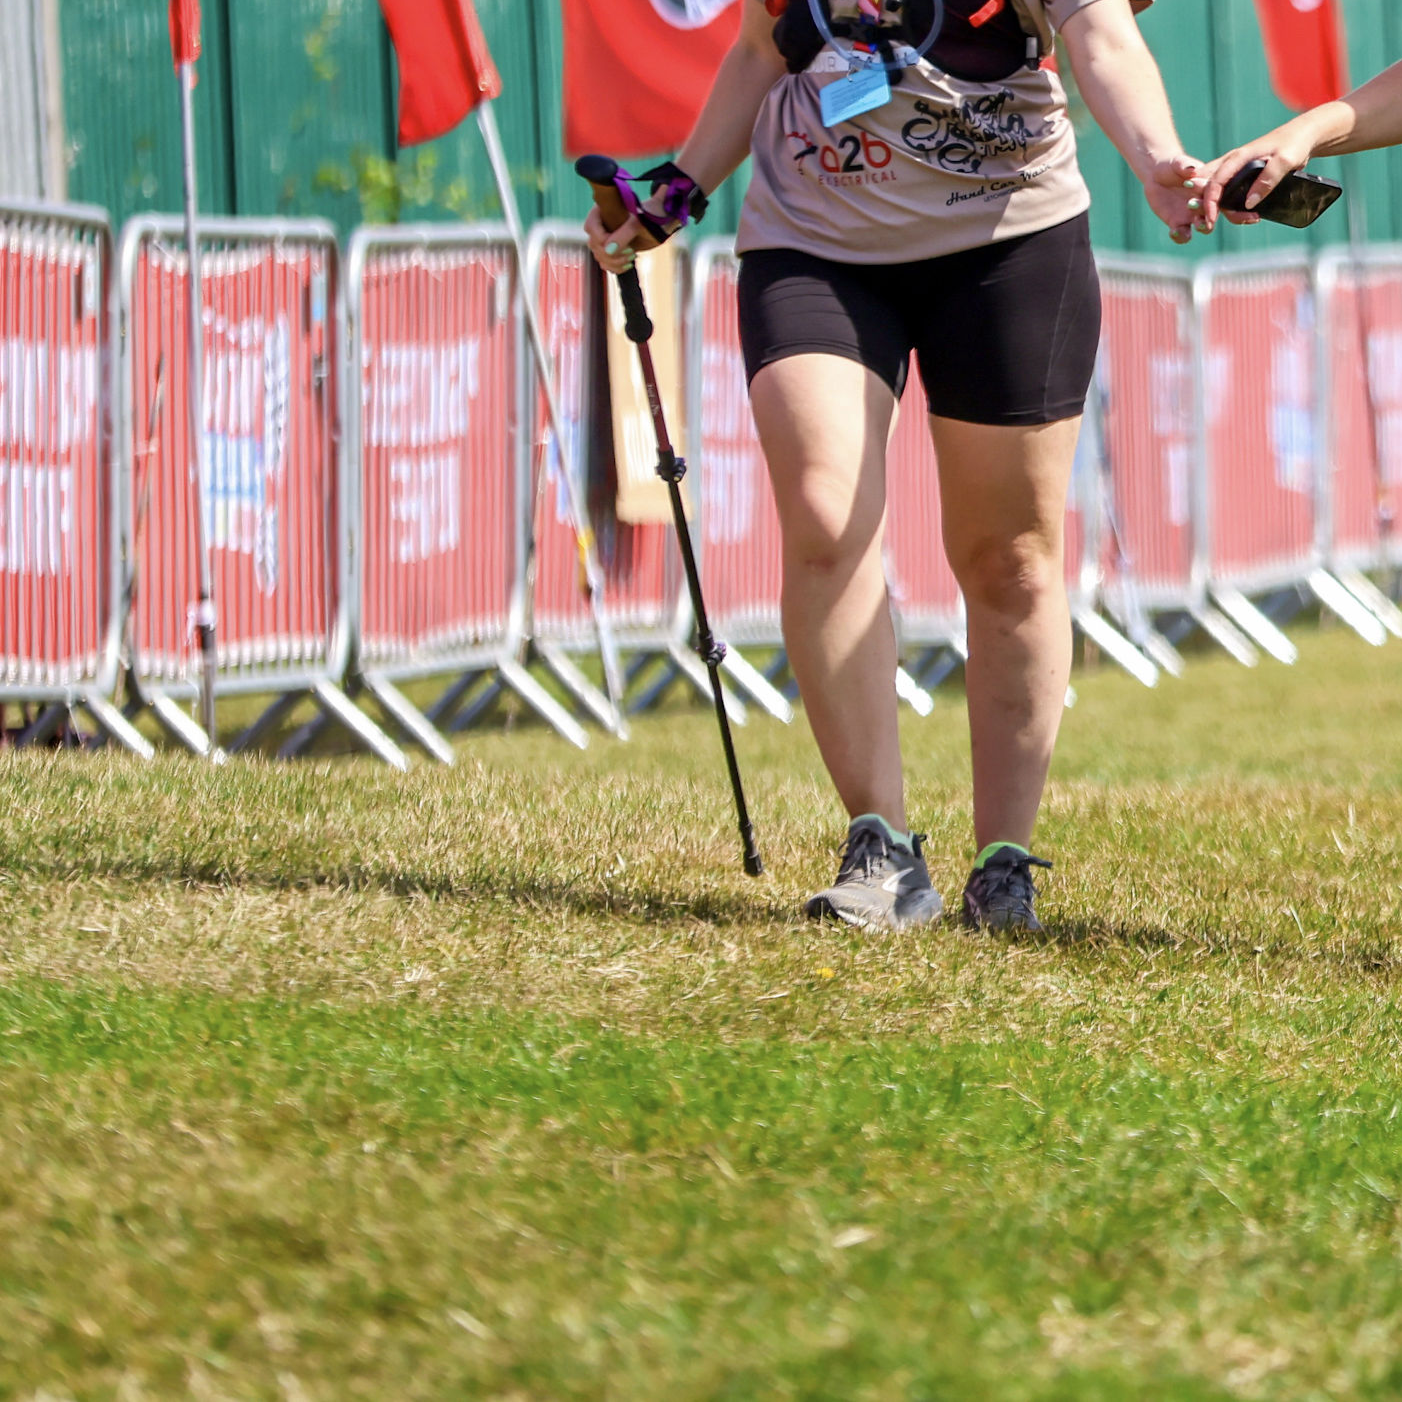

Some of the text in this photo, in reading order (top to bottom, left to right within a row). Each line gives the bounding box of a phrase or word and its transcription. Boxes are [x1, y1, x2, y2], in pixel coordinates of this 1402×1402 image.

[818, 171, 897, 188] ELECTRICAL
[945, 186, 986, 206] Hand
[990, 180, 1016, 191] Car
